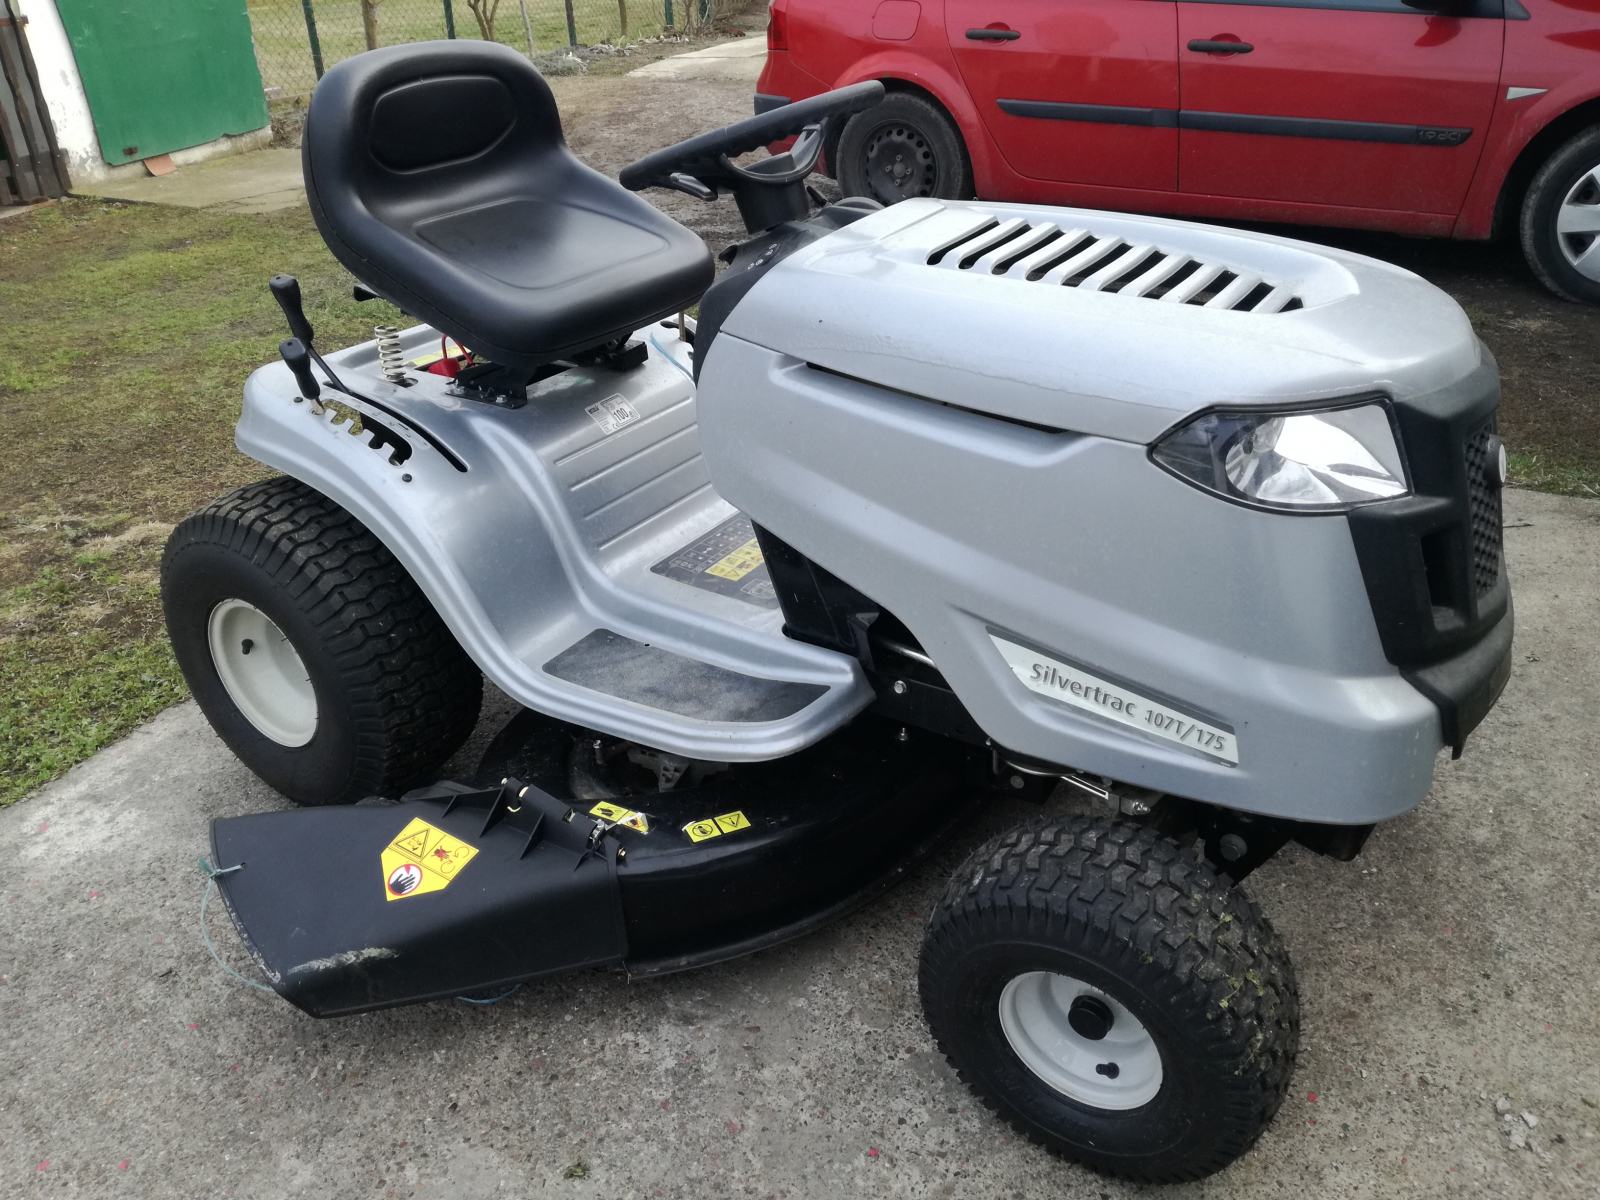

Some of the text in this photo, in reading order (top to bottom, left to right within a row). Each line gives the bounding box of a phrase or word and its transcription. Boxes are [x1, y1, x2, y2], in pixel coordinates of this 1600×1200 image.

[613, 407, 629, 421] 100
[1030, 662, 1225, 752] Silvertrac 107T/175
